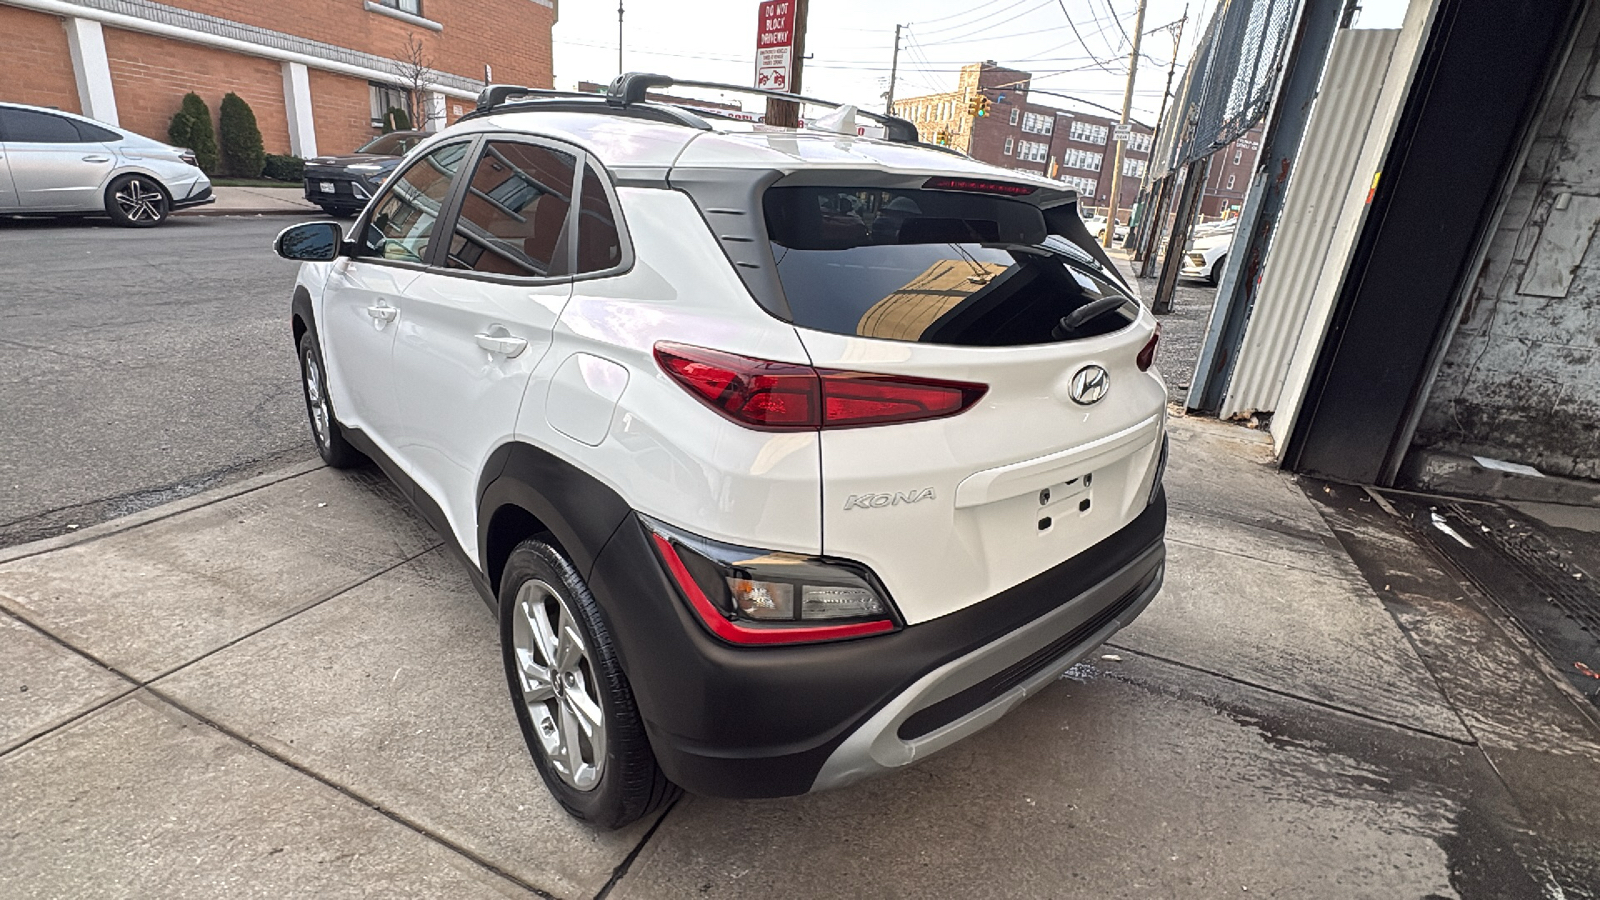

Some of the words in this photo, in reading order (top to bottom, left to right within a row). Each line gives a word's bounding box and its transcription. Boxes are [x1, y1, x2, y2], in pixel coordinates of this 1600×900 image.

[765, 4, 774, 17] DO
[776, 2, 789, 15] NOT
[766, 17, 786, 31] BLOCK
[761, 30, 789, 45] DRIVEWAY
[843, 486, 937, 511] KONA
